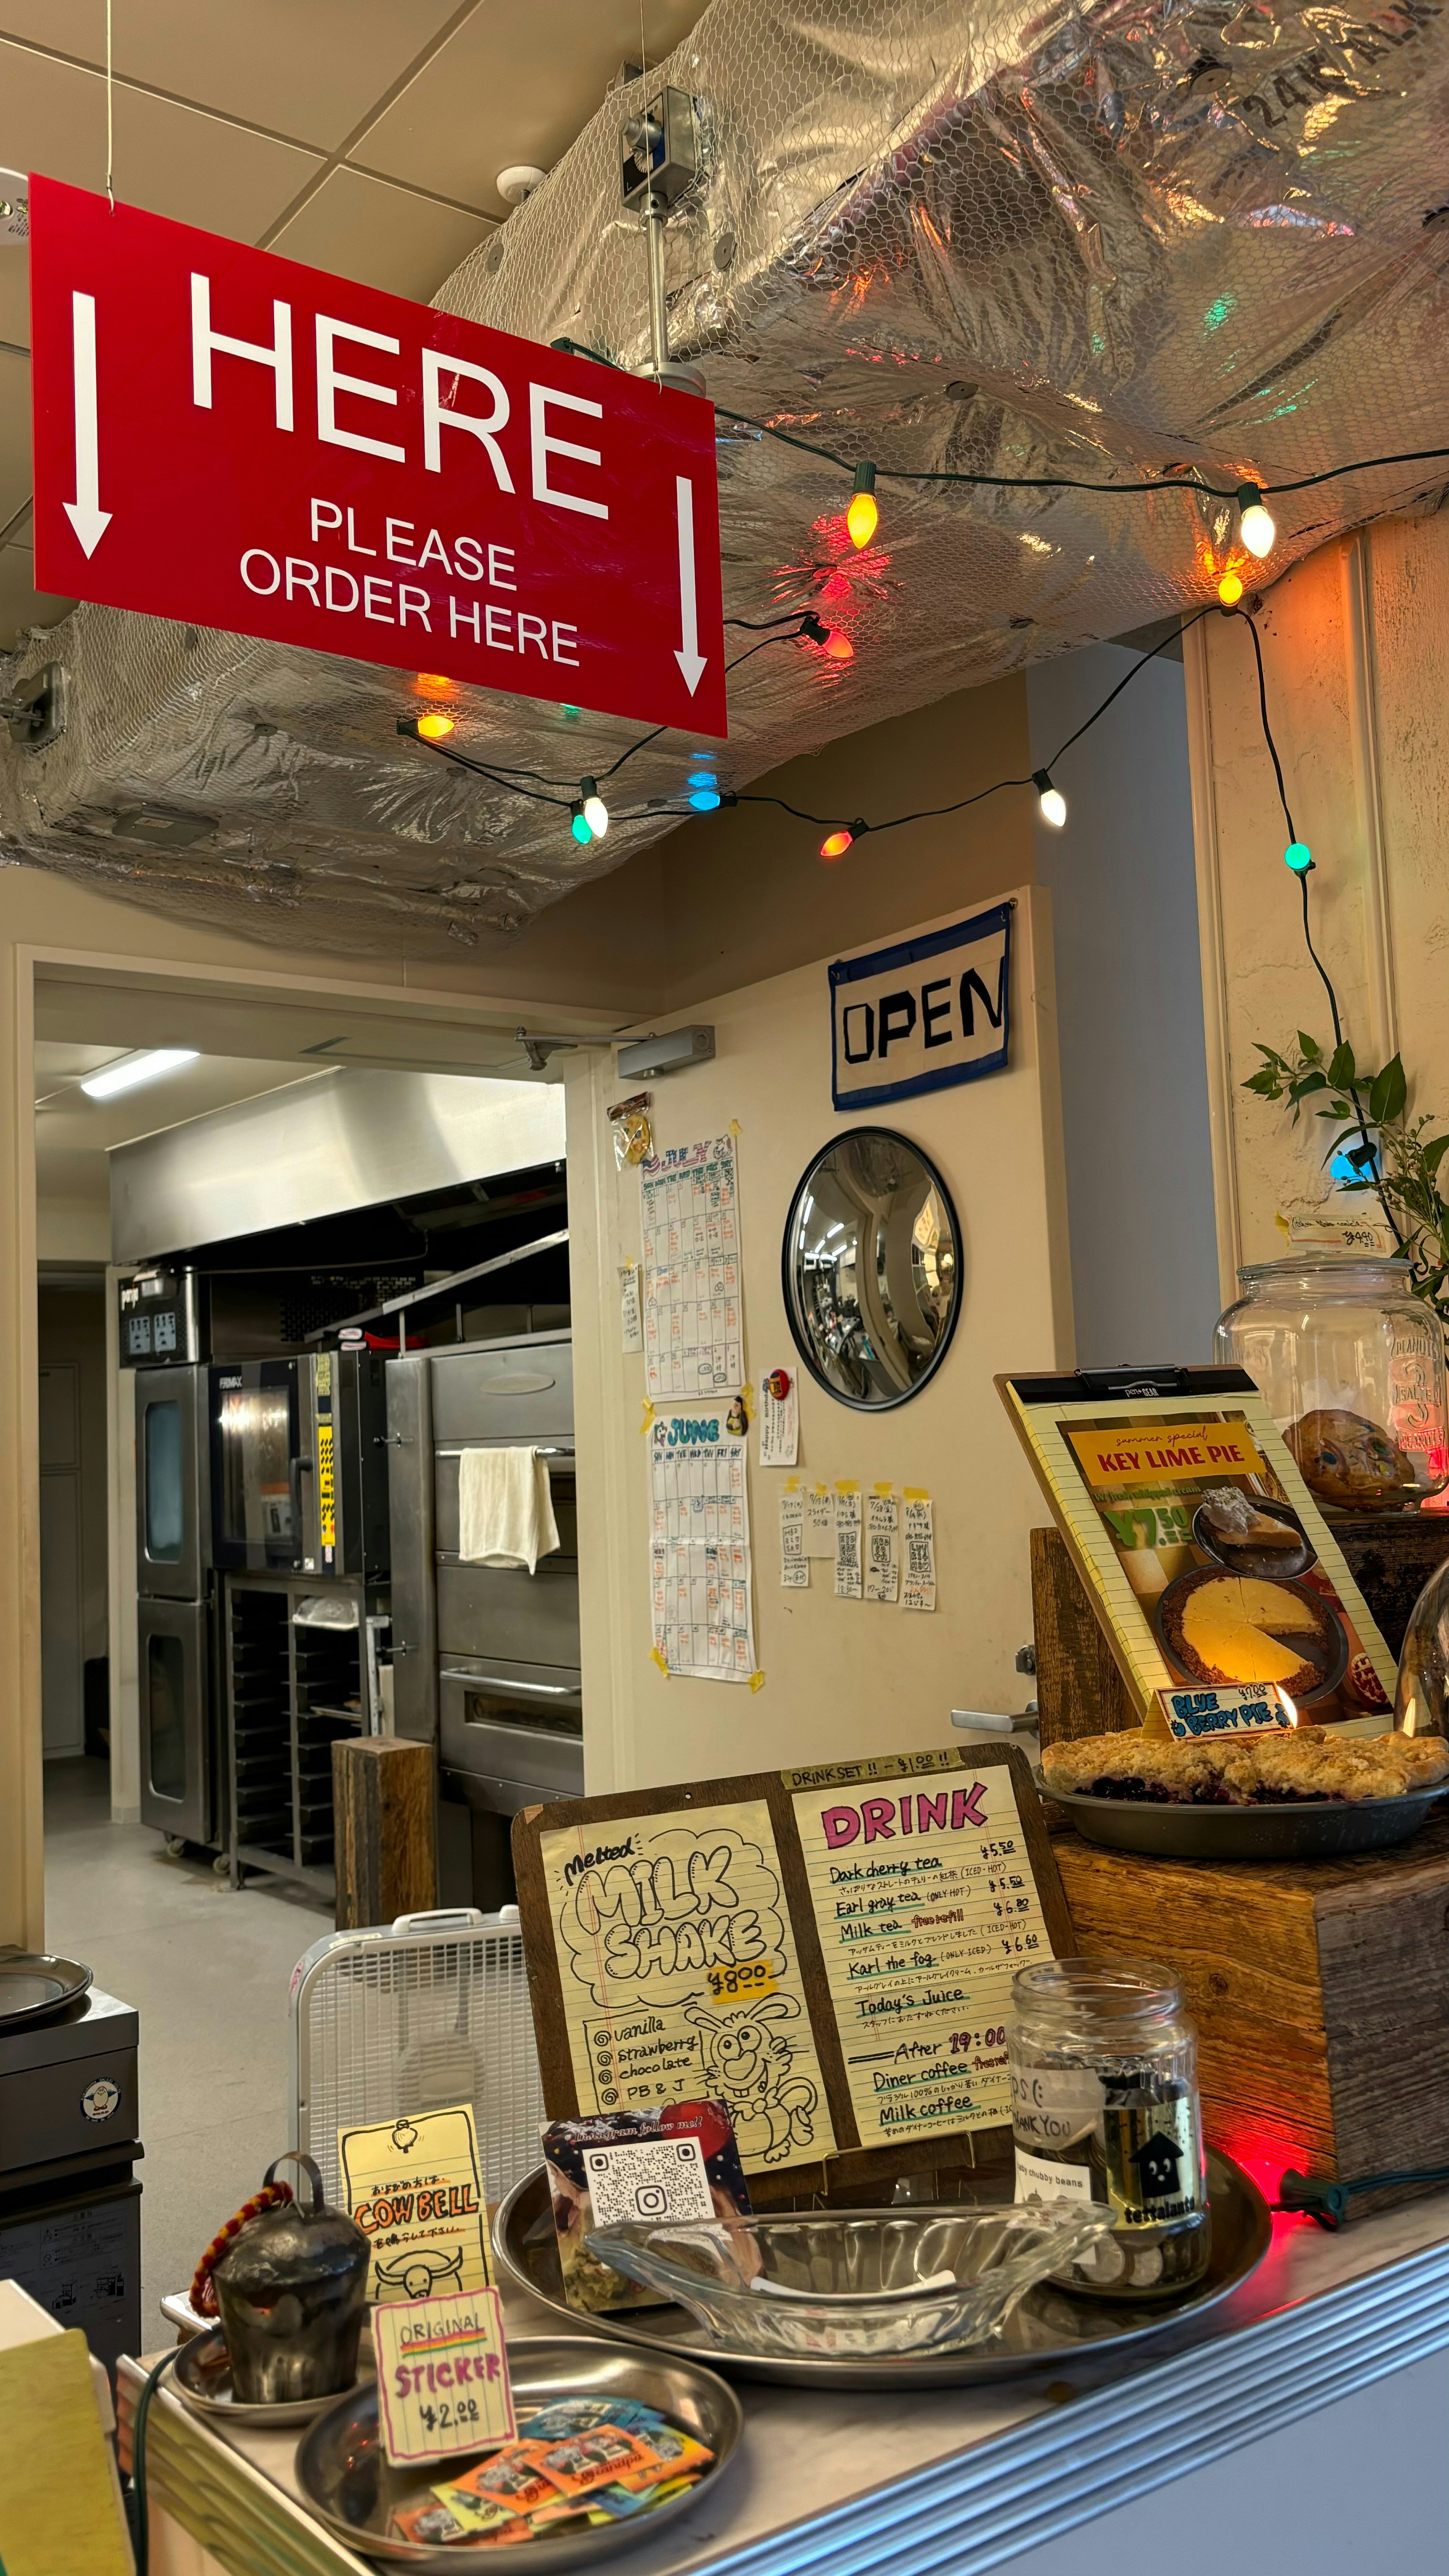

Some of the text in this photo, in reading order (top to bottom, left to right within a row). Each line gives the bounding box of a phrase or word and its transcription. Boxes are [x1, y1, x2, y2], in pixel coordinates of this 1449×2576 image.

[191, 272, 609, 520] HERE
[311, 498, 517, 591] PLEASE
[240, 549, 580, 667] ORDER HERE
[844, 956, 1004, 1064] OPEN
[661, 1140, 712, 1171] JULY
[668, 1418, 720, 1445] JUNE
[1116, 1426, 1208, 1447] summer special
[1097, 1445, 1245, 1472] KEY LIME PIE
[1110, 1491, 1133, 1503] fresh
[1172, 1486, 1201, 1494] cream
[1104, 1507, 1192, 1547] ¥7.50
[1171, 1683, 1268, 1719] BLUE ¥7.00
[1185, 1701, 1274, 1736] BERRY PIE
[821, 1782, 988, 1850] DRINK
[564, 1836, 636, 1887] Melted
[830, 1840, 1016, 1884] Dark cherry tea ¥5.50
[576, 1845, 740, 1936] MILK
[835, 1900, 864, 1918] Earl
[867, 1895, 896, 1913] gray
[898, 1890, 921, 1903] tea
[949, 1885, 971, 1898] HOT)
[988, 1875, 1025, 1892] ¥5.50
[841, 1898, 1030, 1941] Milk tea free refill ¥6.80
[604, 1909, 767, 1979] SHAKE
[848, 1934, 1040, 1979] Karl the fog (ONLY ICED) ¥6.60
[855, 1988, 964, 2016] Today's Juice
[614, 2016, 665, 2041] vanilla
[894, 2026, 1006, 2064] After 19:00
[618, 2036, 699, 2063] strawberry
[619, 2056, 693, 2080] chocolate
[873, 2071, 916, 2091] Diner
[920, 2061, 968, 2081] coffee
[627, 2077, 686, 2100] PB & J
[1012, 2076, 1029, 2103] PS
[880, 2095, 973, 2126] Milk coffee
[1039, 2114, 1070, 2136] YOU
[573, 2116, 703, 2142] Instagram follow me!!
[1029, 2169, 1052, 2185] chubby
[1055, 2175, 1083, 2188] beans
[354, 2183, 480, 2234] COW BELL
[400, 2313, 485, 2344] ORIGINAL
[395, 2353, 501, 2399] STICKER
[419, 2399, 480, 2432] ¥2.00
